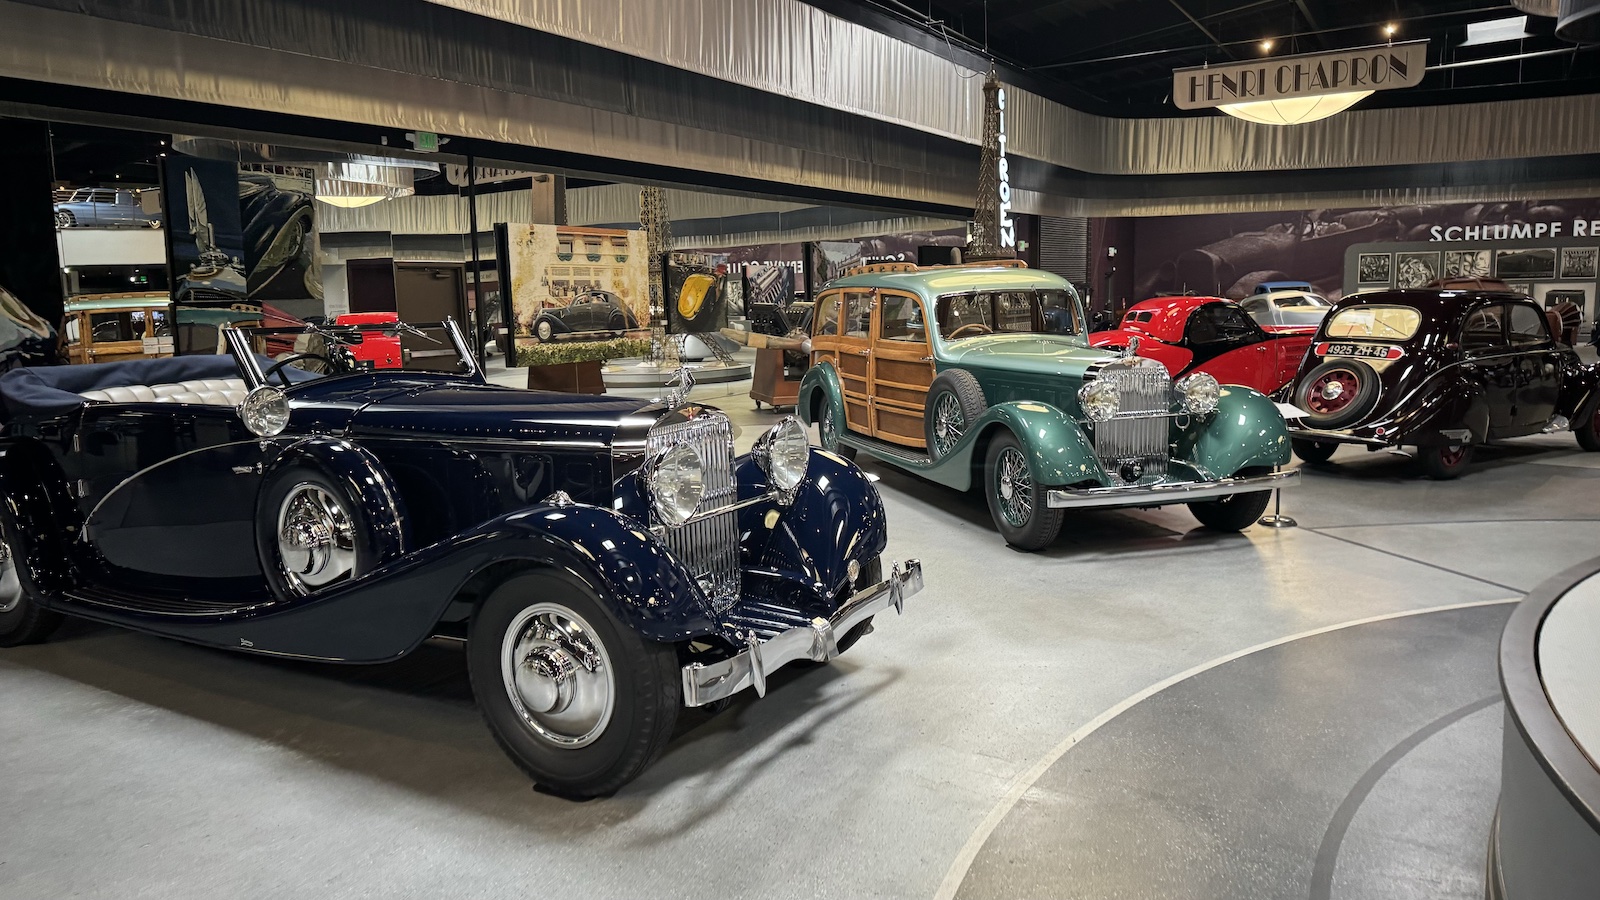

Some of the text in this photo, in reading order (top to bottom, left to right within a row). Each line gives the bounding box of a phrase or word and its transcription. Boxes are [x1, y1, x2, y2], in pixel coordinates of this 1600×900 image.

[1188, 51, 1409, 102] HENRI CHAPRON
[1429, 221, 1562, 242] SCHLUMPF
[1328, 345, 1353, 355] 4925
